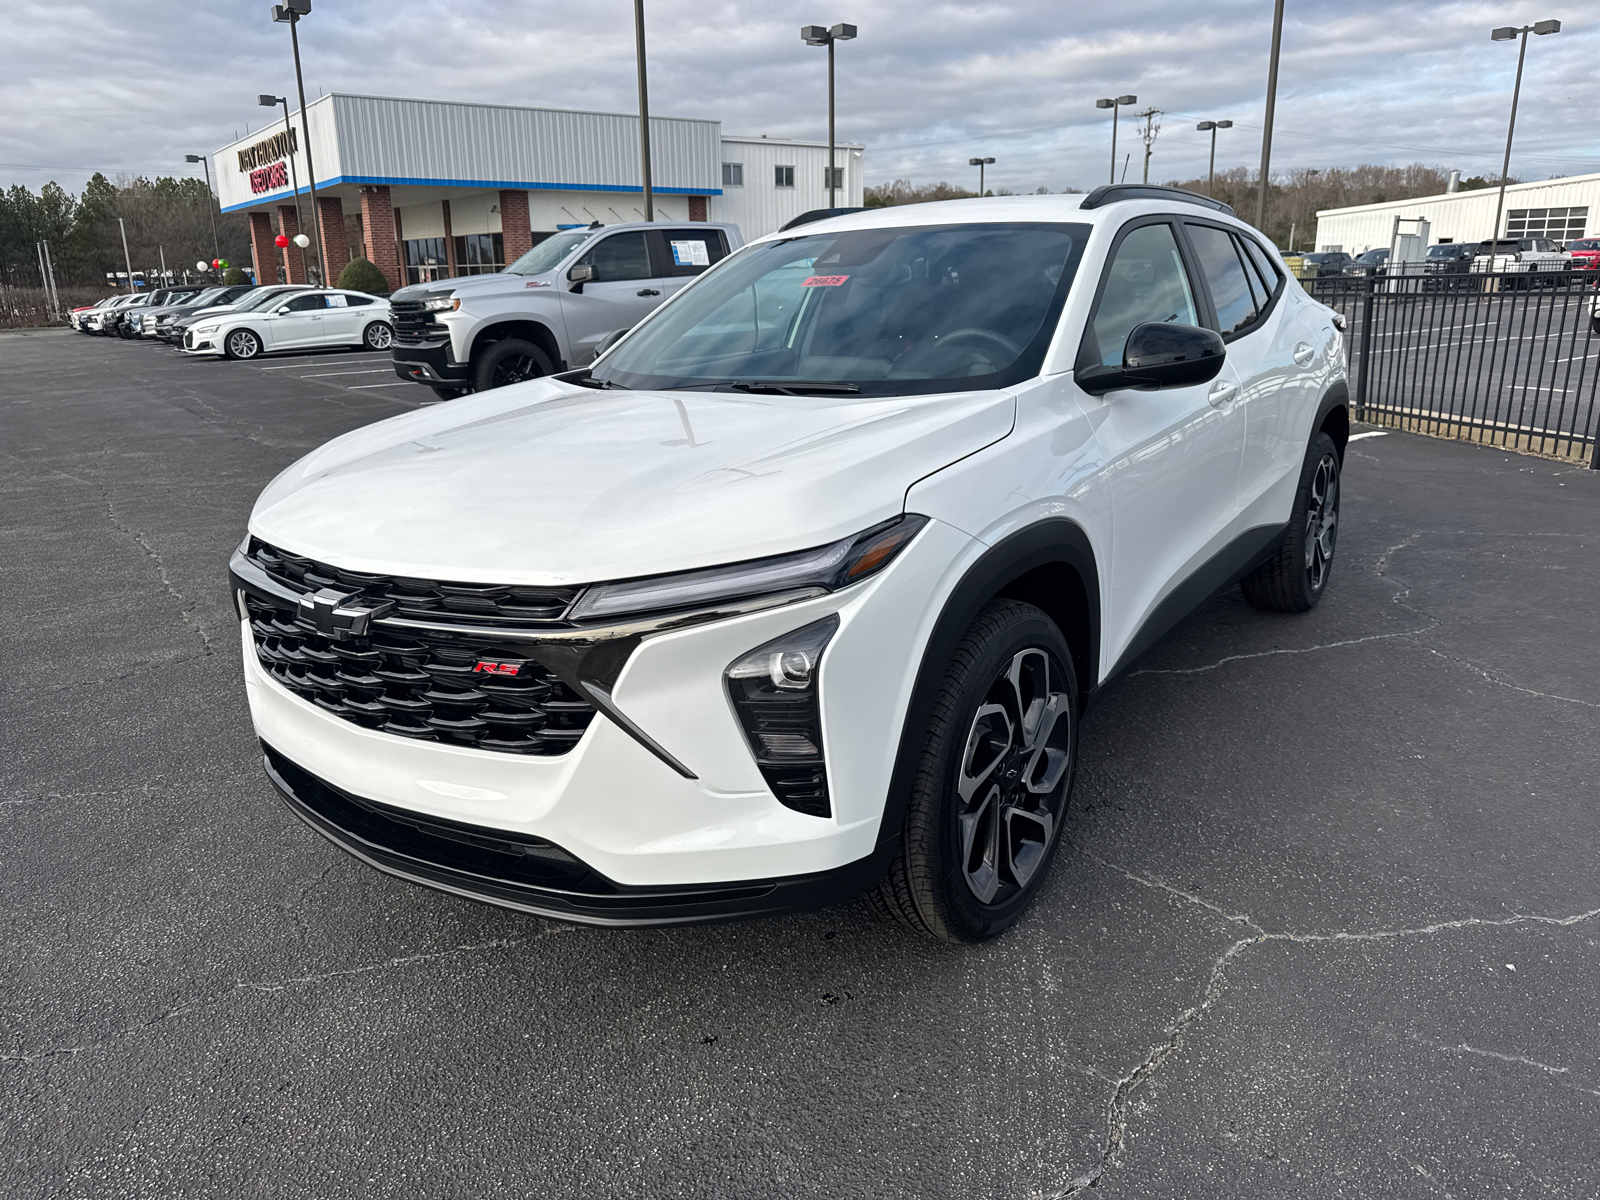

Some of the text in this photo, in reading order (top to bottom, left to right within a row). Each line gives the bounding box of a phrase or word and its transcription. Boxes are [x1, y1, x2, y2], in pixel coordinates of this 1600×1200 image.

[250, 161, 287, 193] USED CARS
[472, 661, 520, 676] RS
